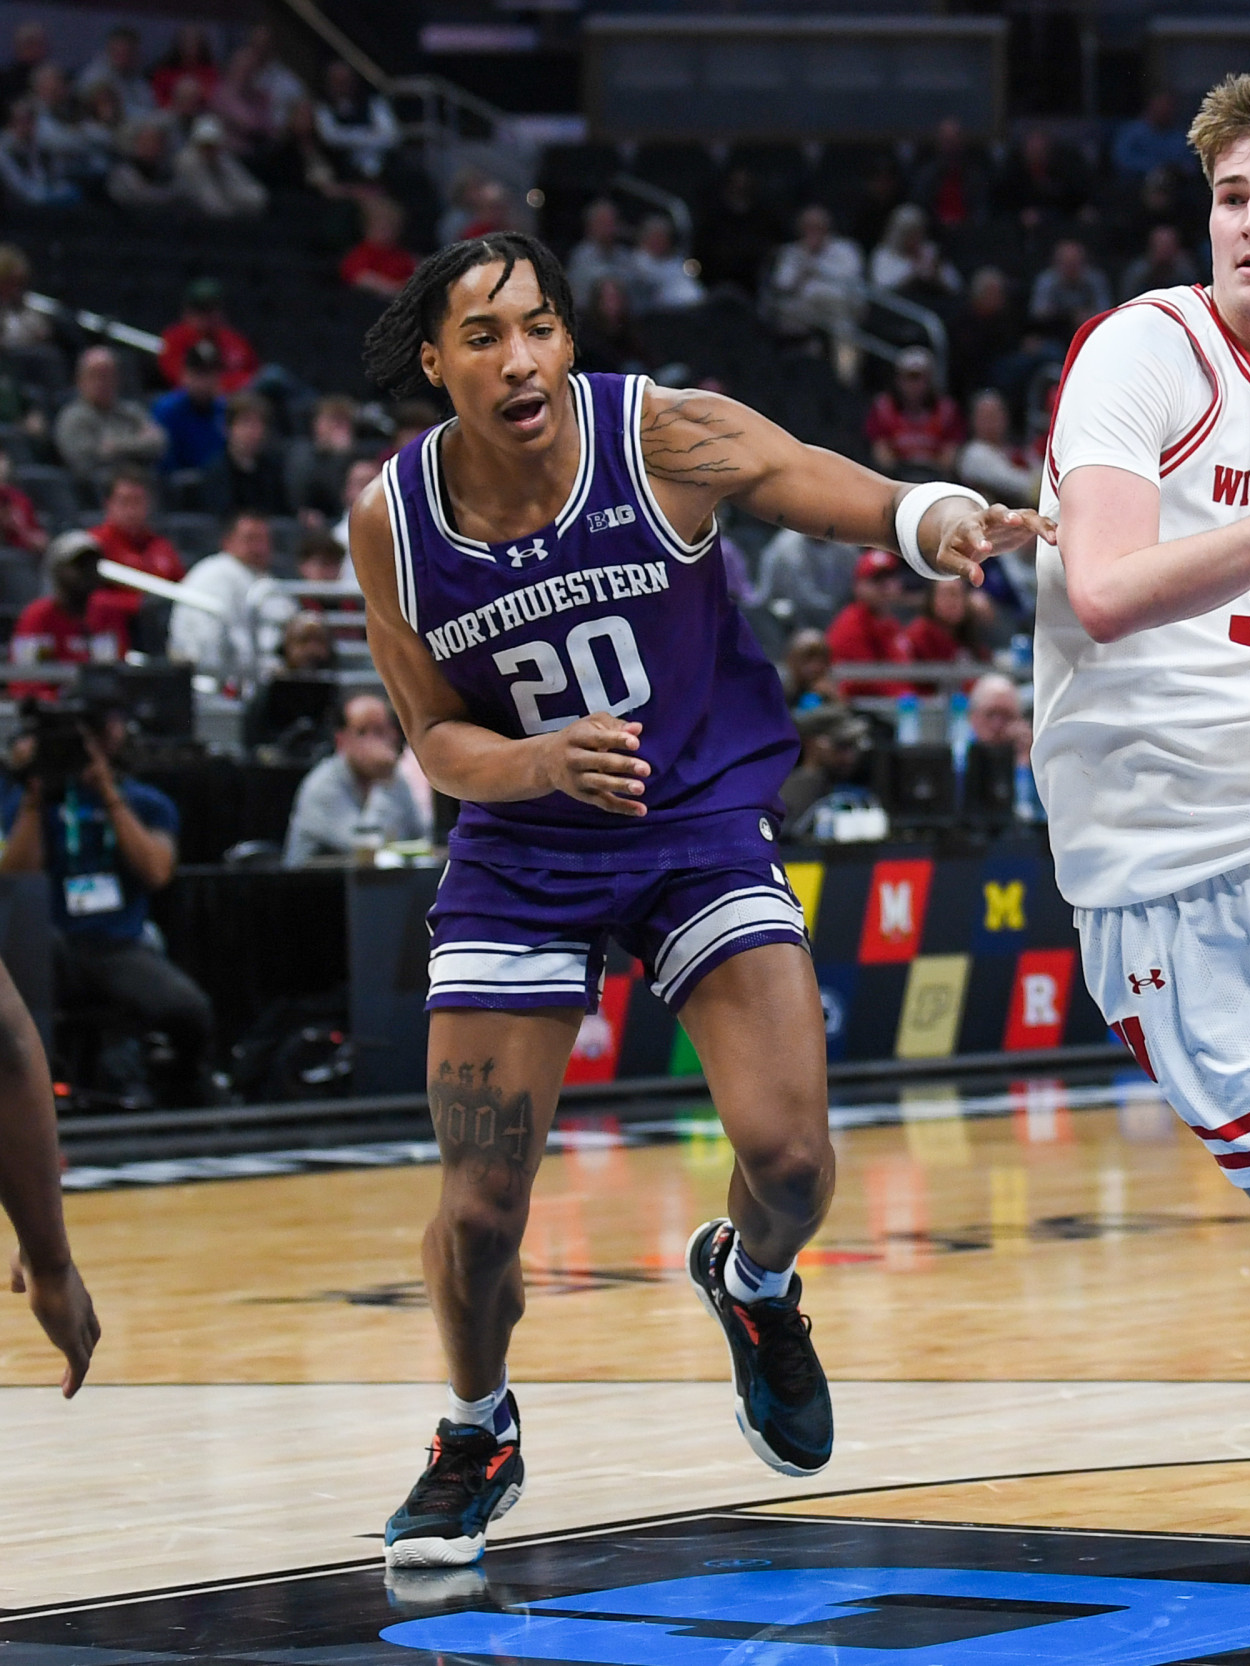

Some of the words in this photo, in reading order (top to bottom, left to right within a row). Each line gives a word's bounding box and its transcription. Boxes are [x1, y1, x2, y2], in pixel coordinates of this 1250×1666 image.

[425, 561, 670, 661] NORTHWESTERN
[492, 615, 651, 736] 20
[879, 881, 913, 934] M
[984, 879, 1025, 931] M
[1023, 973, 1059, 1027] R
